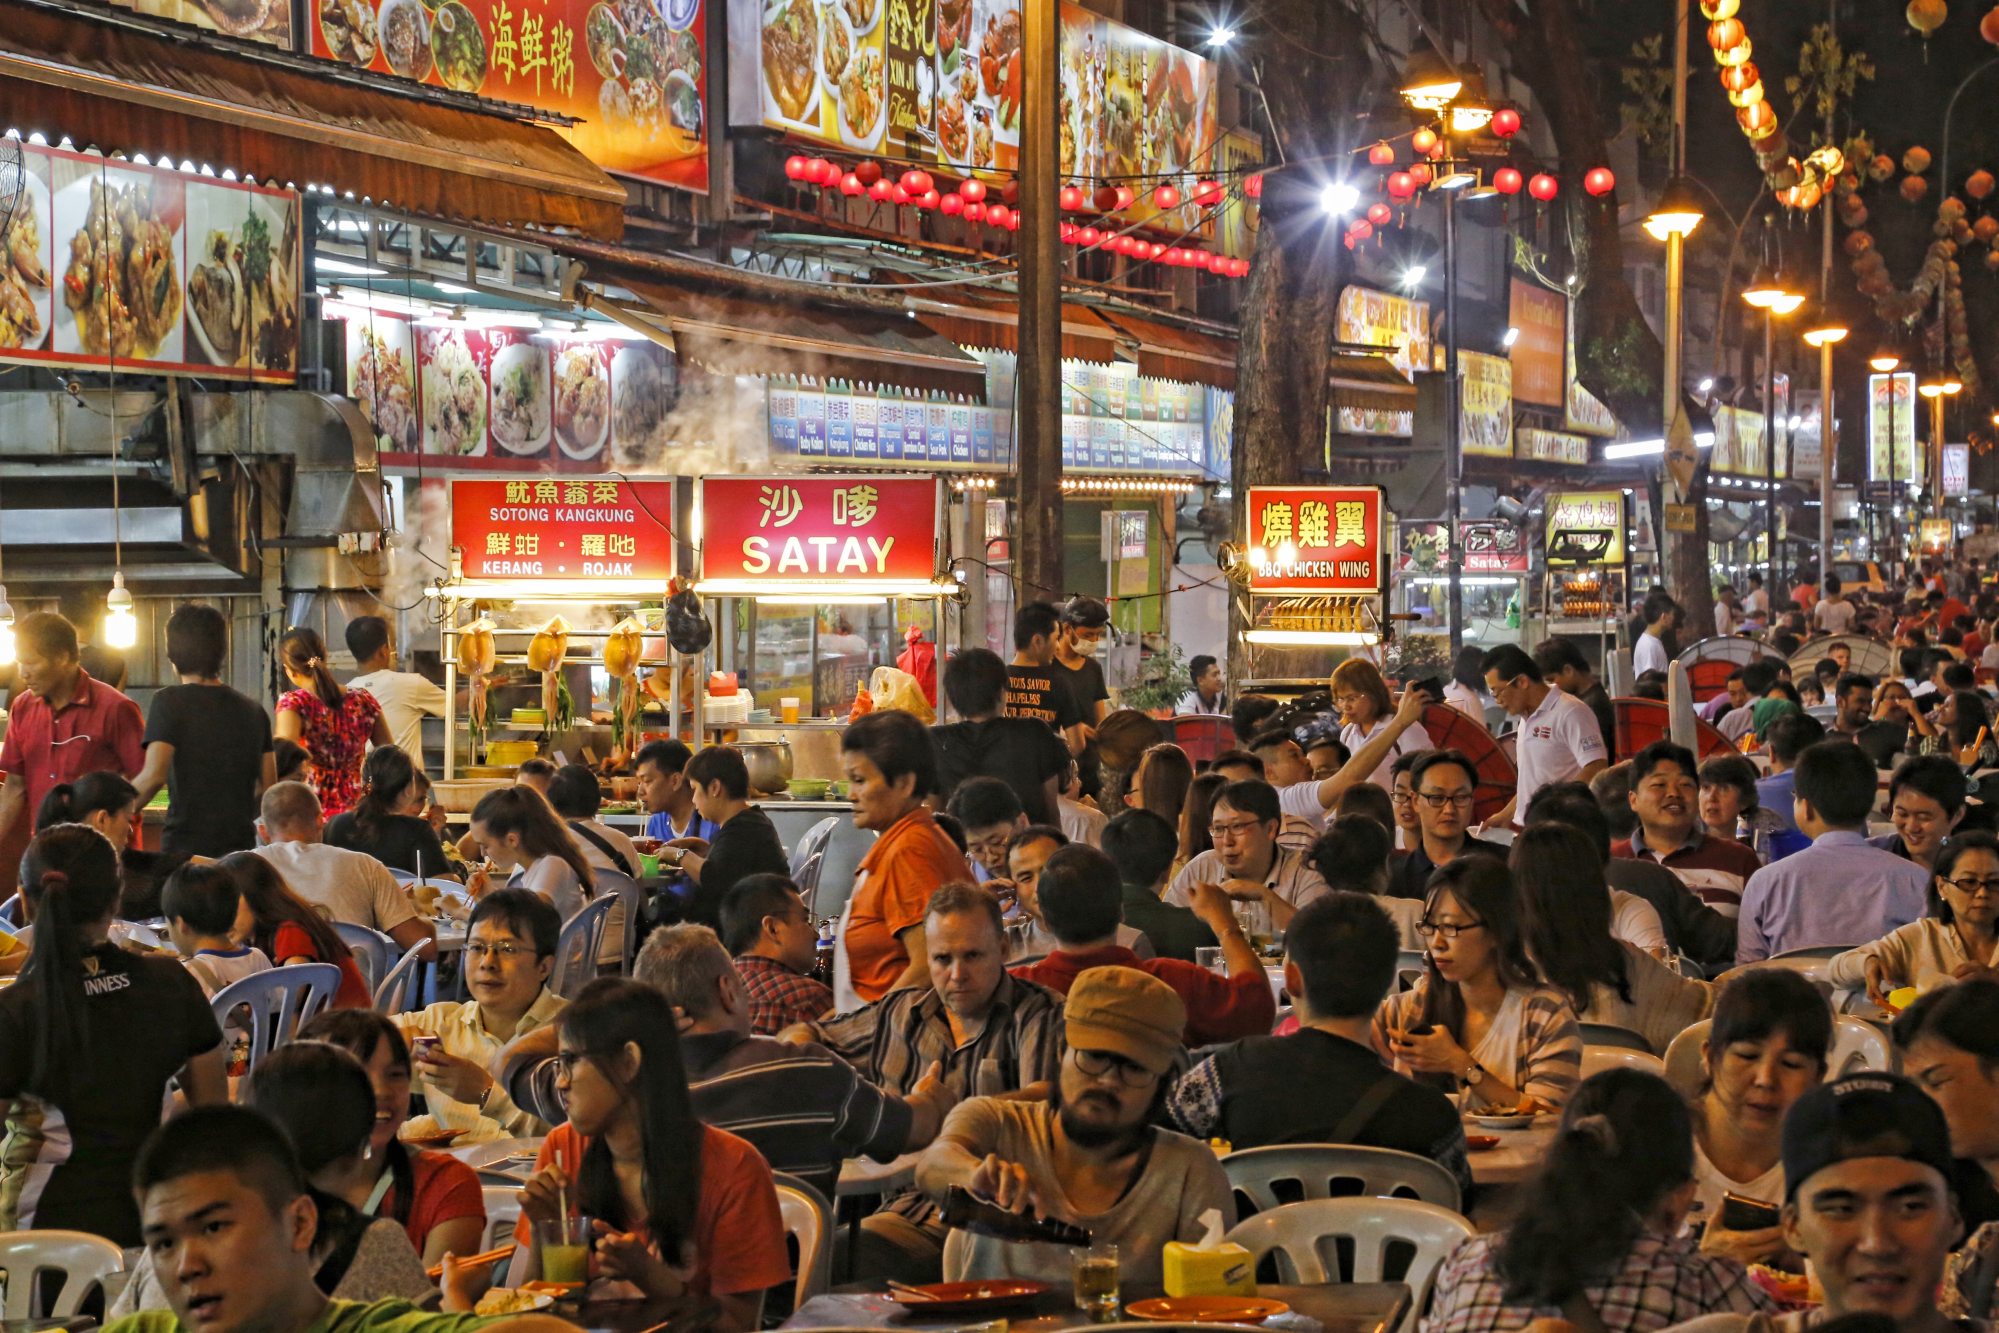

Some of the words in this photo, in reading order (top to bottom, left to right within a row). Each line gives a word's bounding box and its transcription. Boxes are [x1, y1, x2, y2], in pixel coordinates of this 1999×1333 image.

[889, 58, 905, 89] XIN
[906, 64, 914, 91] JI
[490, 508, 549, 522] SOTONG
[555, 509, 634, 523] KANGKUNG
[742, 536, 895, 574] SATAY
[482, 561, 543, 575] KERANG
[583, 562, 633, 576] ROJAK
[1258, 561, 1282, 578] BBQ
[1286, 561, 1334, 578] CHICKEN
[1339, 561, 1370, 578] WING
[1469, 556, 1509, 570] Satay
[1027, 679, 1051, 691] SAVIOR
[1007, 691, 1040, 705] HAPELESS
[84, 973, 130, 996] INNESS
